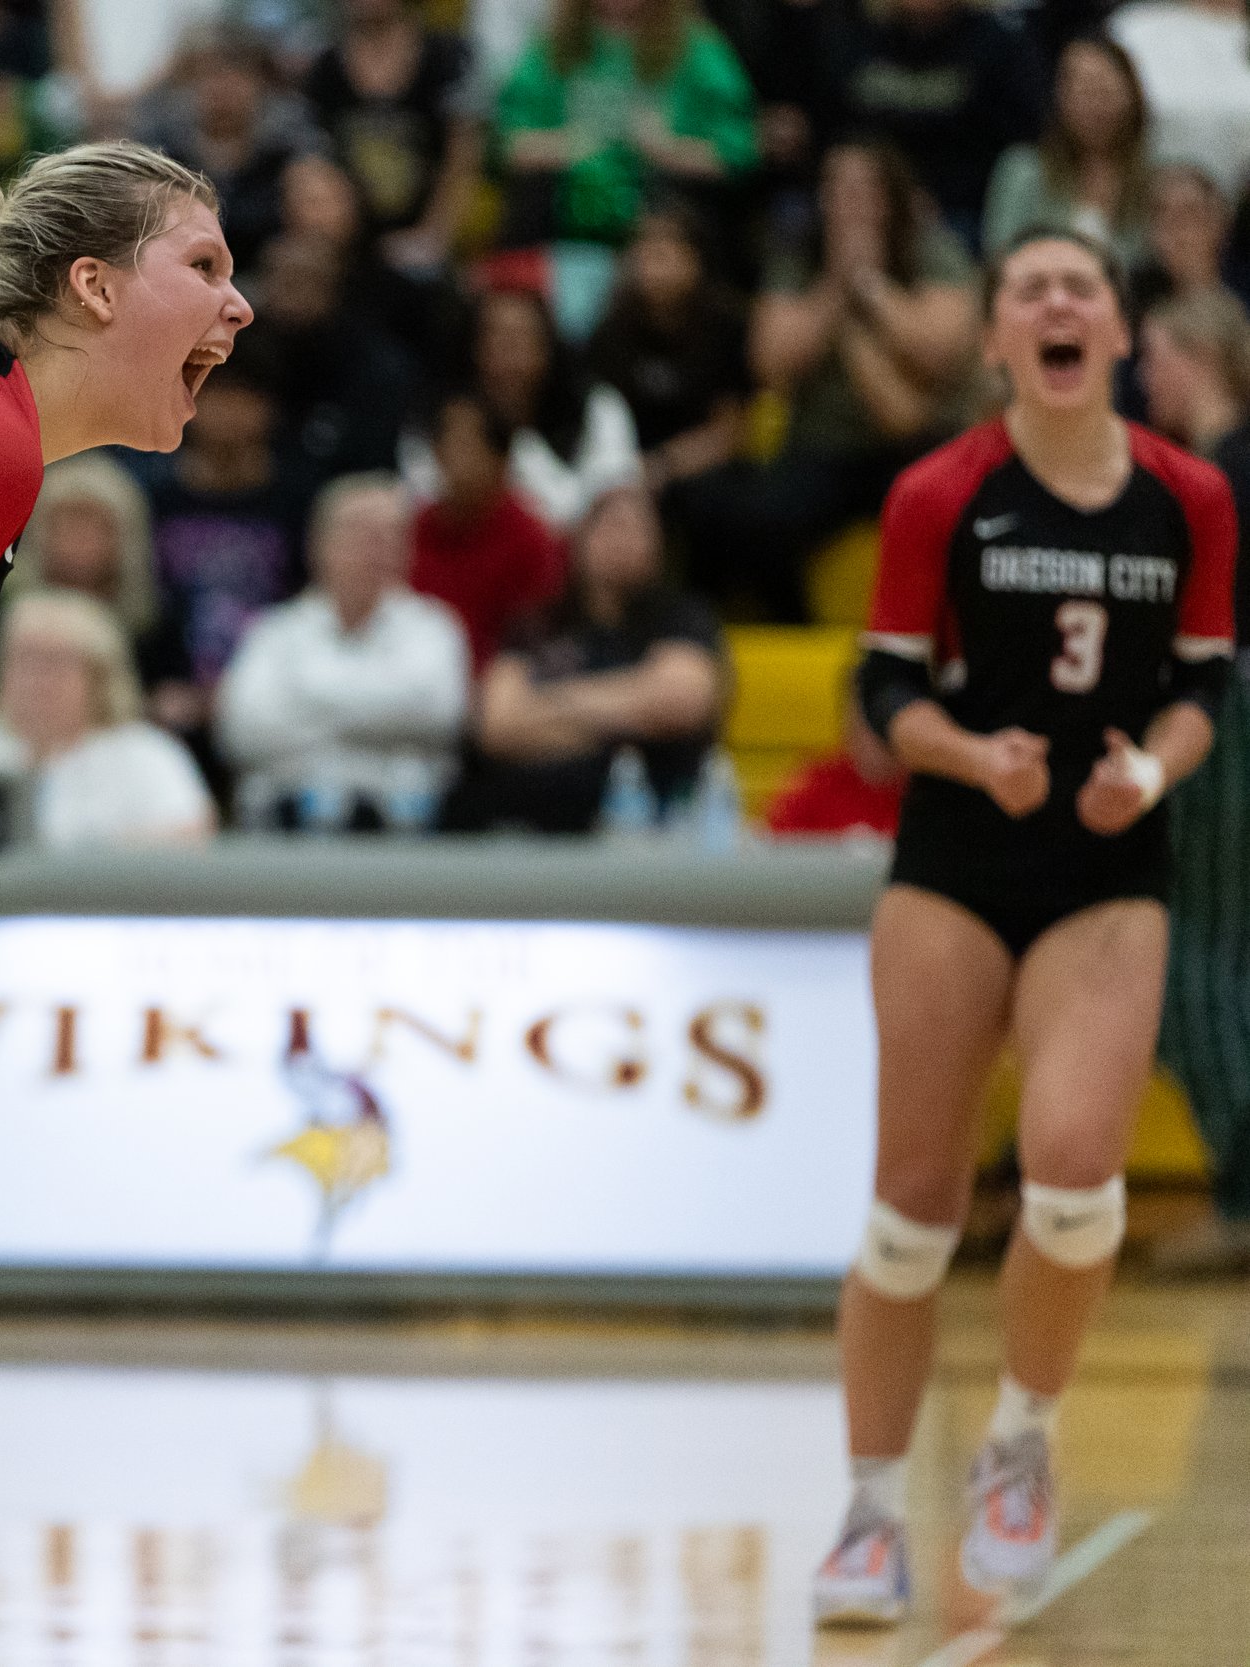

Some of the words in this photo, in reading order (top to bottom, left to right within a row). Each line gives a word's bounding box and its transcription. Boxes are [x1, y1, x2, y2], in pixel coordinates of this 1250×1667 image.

[980, 547, 1104, 595] OREGON
[1108, 554, 1176, 601] CITY
[1051, 601, 1107, 692] 3
